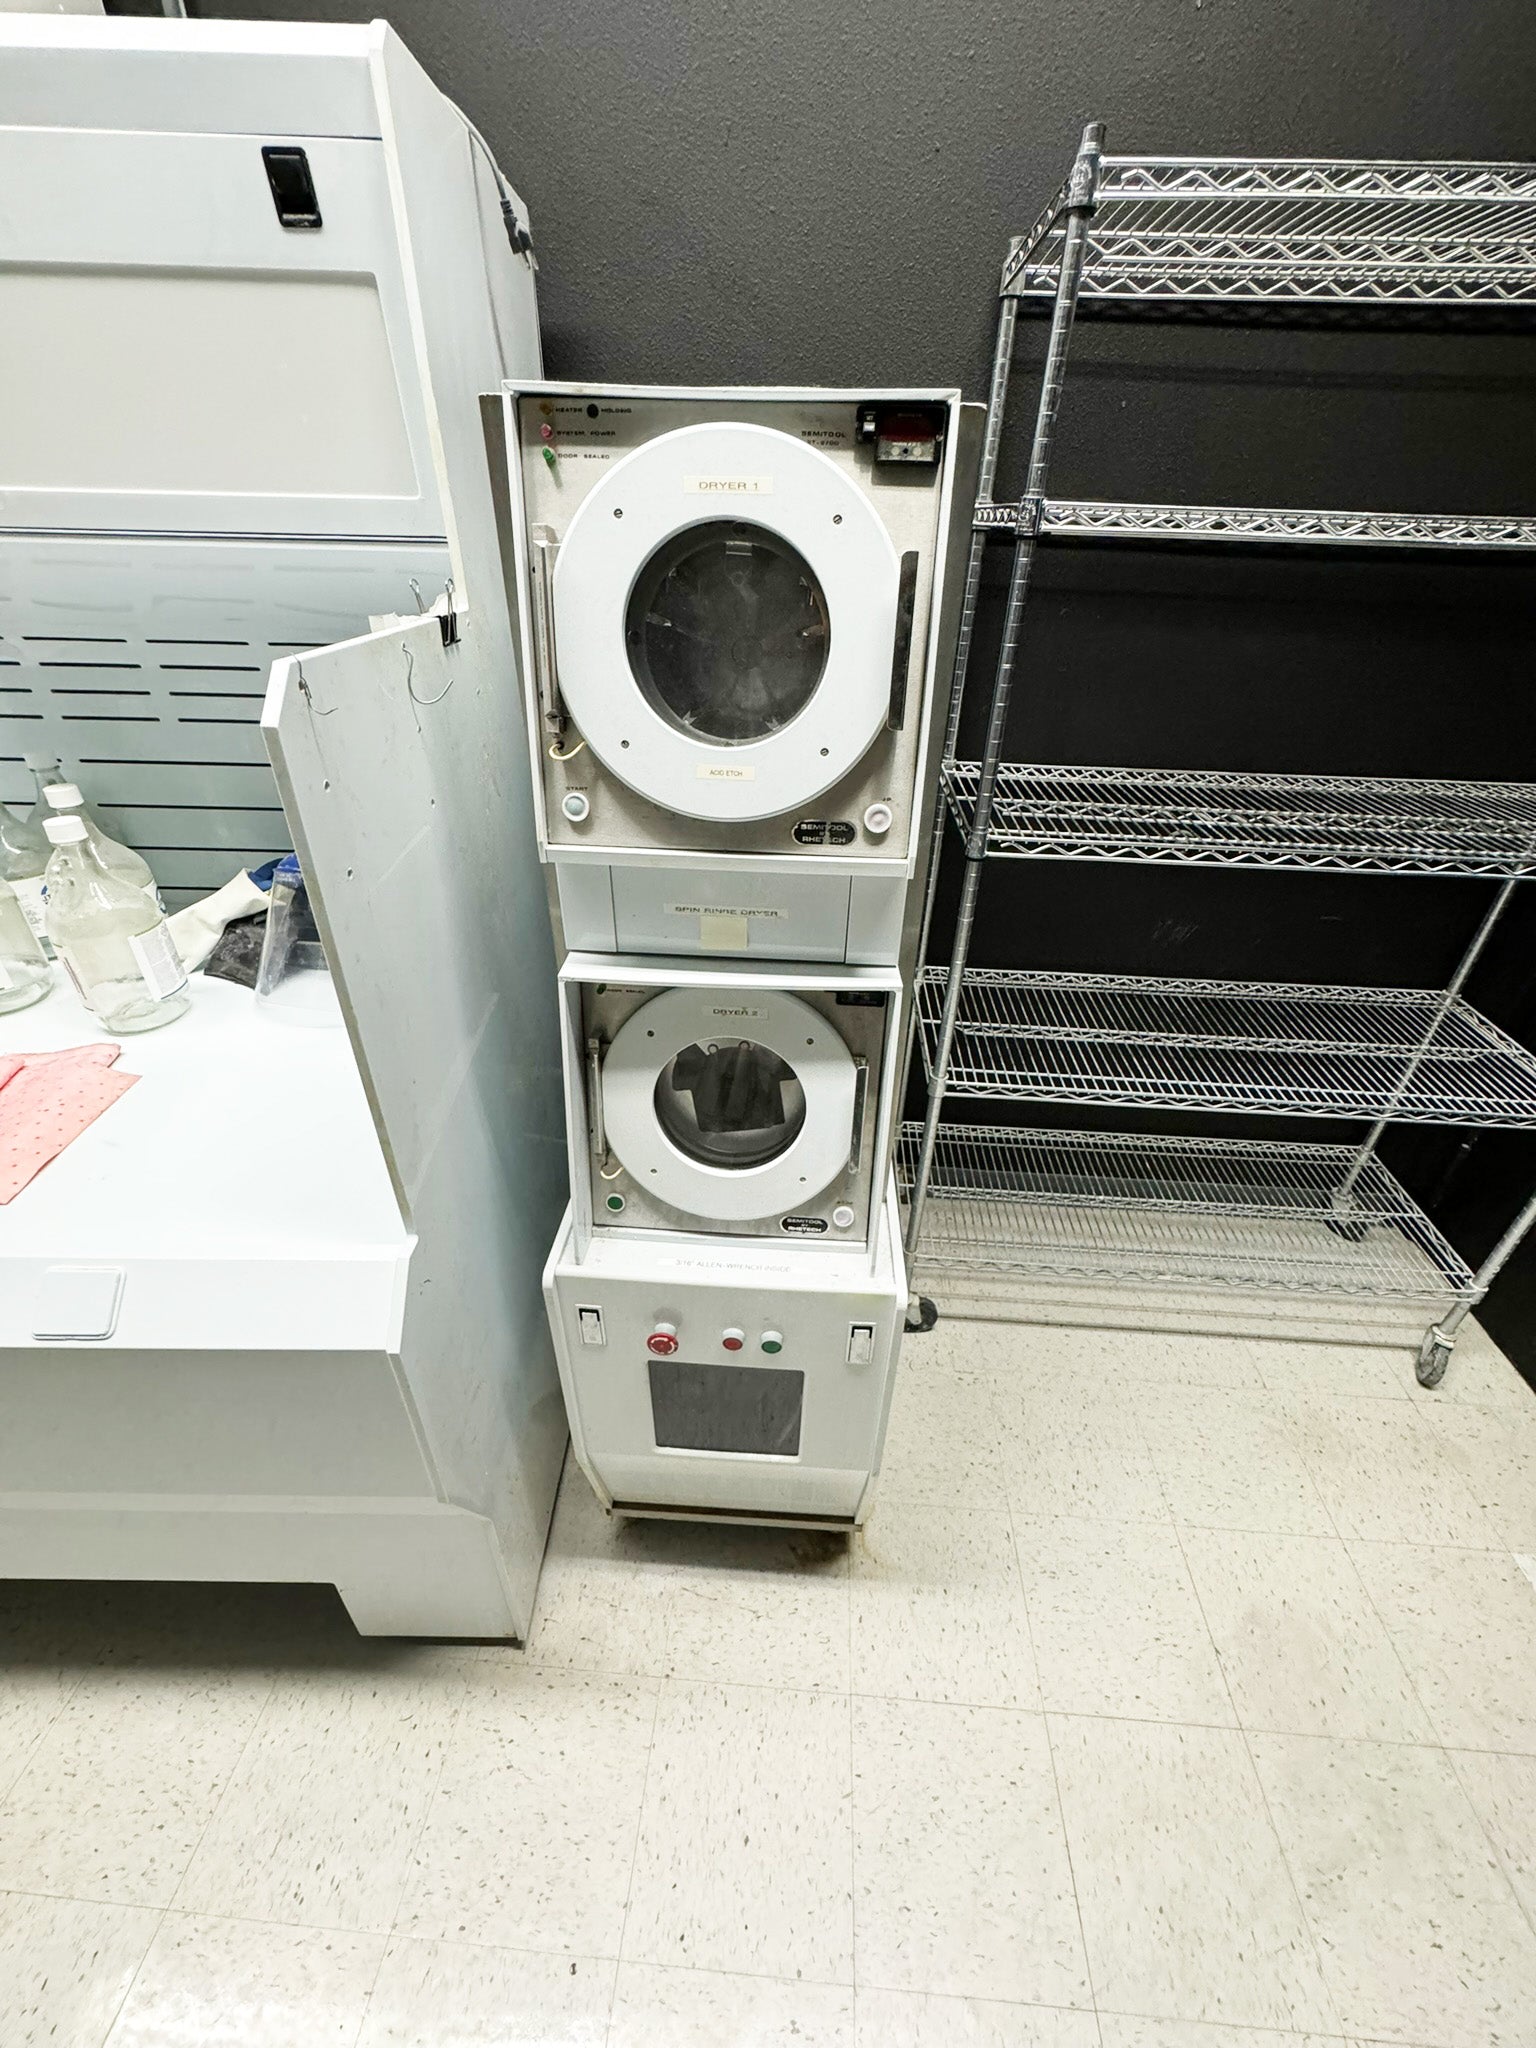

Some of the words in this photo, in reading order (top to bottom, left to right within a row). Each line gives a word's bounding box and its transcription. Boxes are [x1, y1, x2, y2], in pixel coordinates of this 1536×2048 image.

[801, 430, 846, 438] SEMITOOL
[699, 481, 747, 490] DRYER
[753, 482, 758, 491] 1
[740, 909, 778, 917] DRYER
